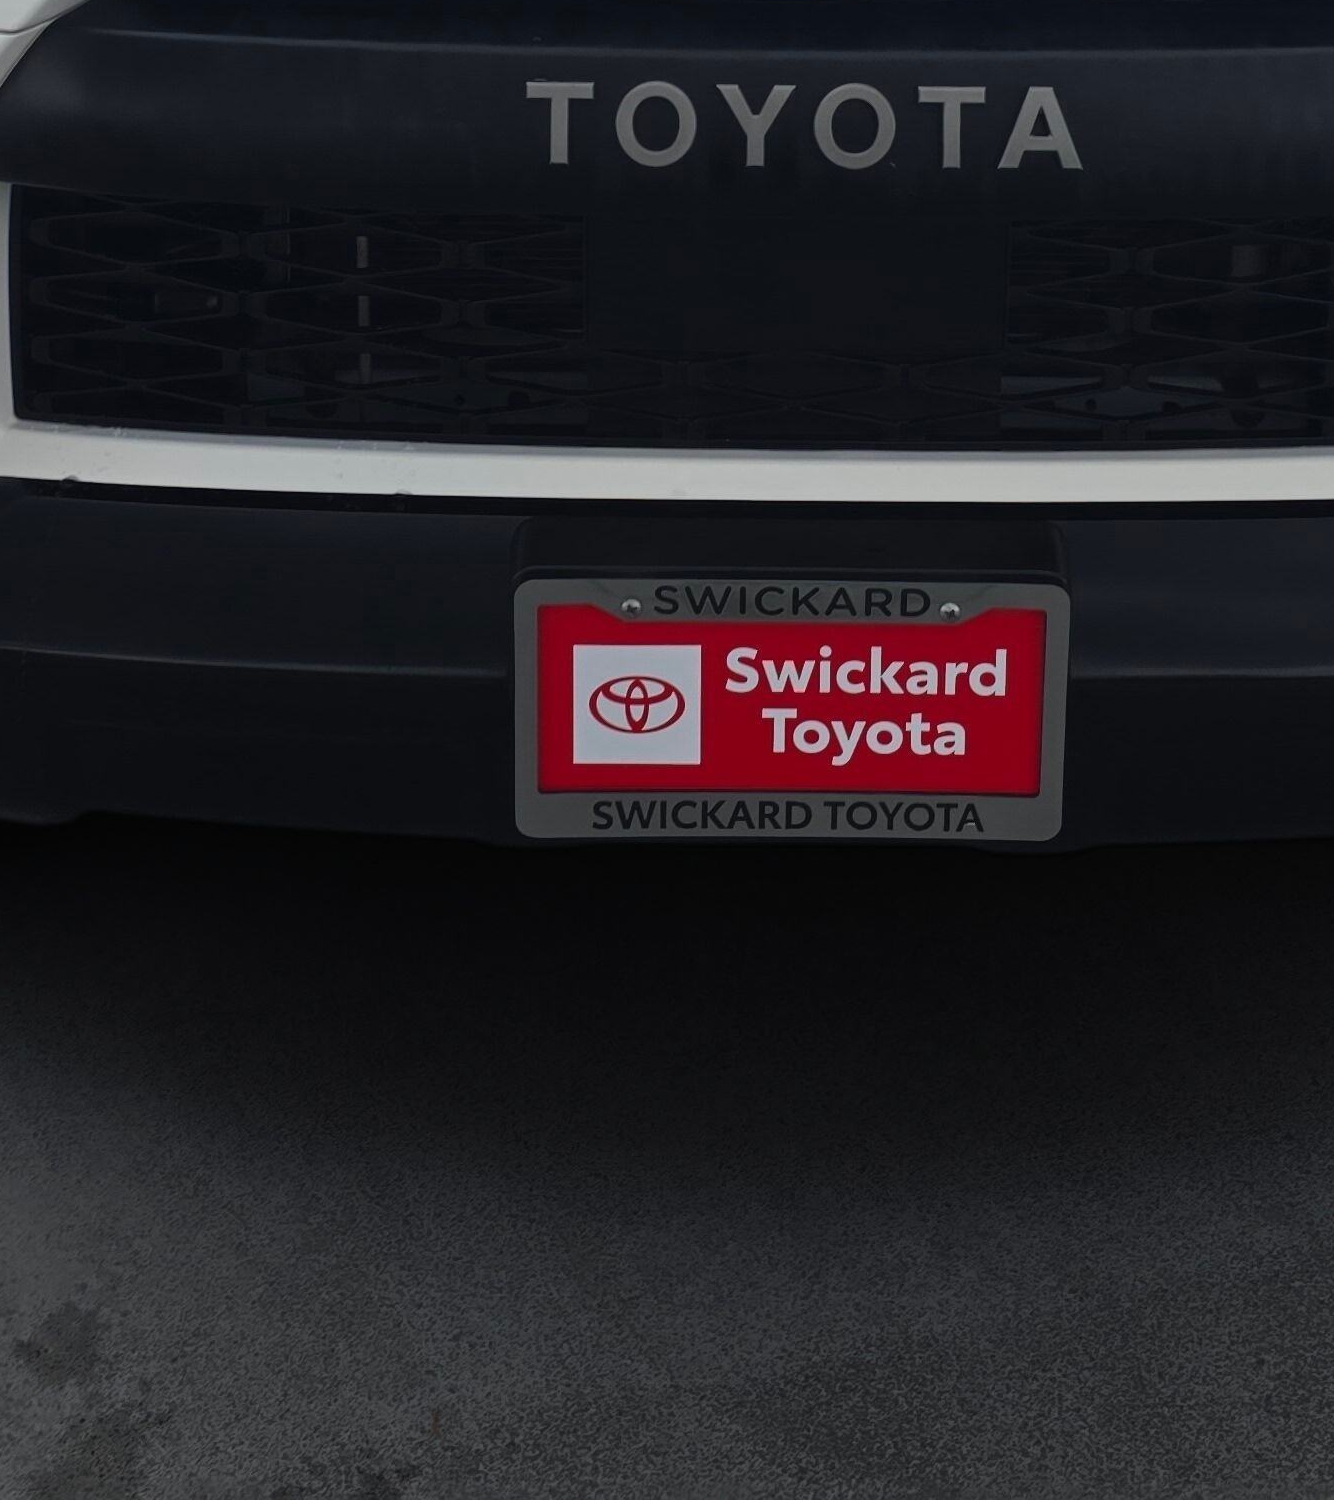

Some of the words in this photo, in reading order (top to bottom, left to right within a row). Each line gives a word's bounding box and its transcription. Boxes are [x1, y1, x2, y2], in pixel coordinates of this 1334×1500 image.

[525, 80, 1084, 170] TOYOTA
[652, 584, 932, 618] SWICKARD
[724, 644, 1007, 698] Swickard
[761, 707, 967, 767] Toyota
[591, 799, 813, 832] SWICKARD
[822, 801, 985, 834] TOYOTA
